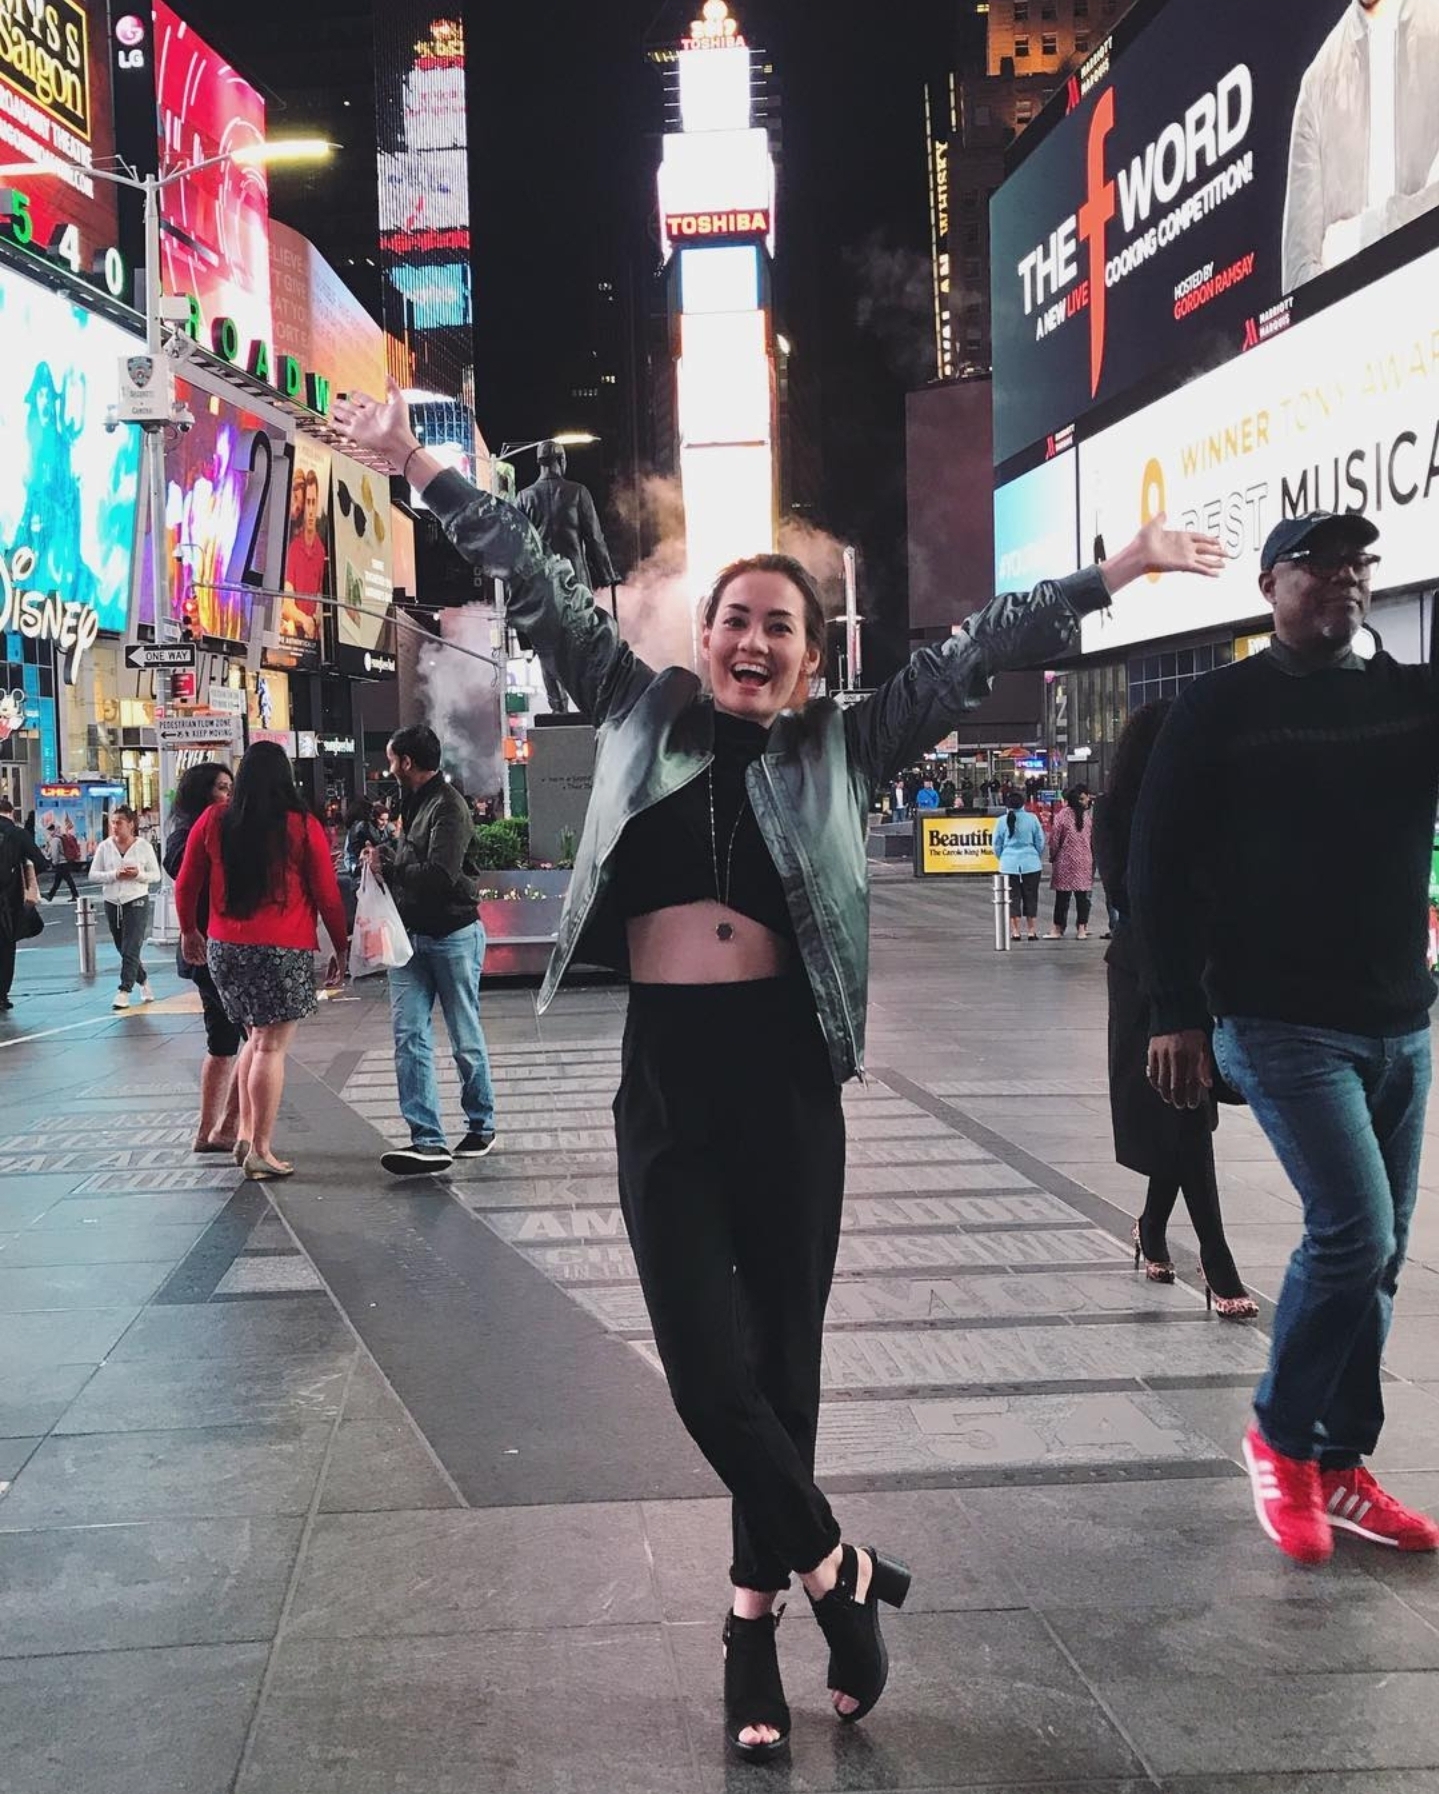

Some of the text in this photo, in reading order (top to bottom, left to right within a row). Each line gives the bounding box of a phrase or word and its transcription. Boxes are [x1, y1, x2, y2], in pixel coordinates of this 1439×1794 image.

[681, 35, 746, 50] TOSHIBA
[118, 49, 144, 69] LG
[1081, 35, 1113, 79] MARRIOTT
[1081, 57, 1110, 96] MARQUIS
[1018, 213, 1077, 315] THE
[1117, 63, 1252, 233] WORD
[667, 212, 767, 235] TOSHIBA
[1035, 317, 1045, 341] A
[1044, 297, 1067, 335] NEW
[1066, 280, 1089, 318] LIVE
[1104, 227, 1157, 288] COOKING
[1174, 261, 1214, 300] HOSTED BY
[1174, 252, 1255, 320] GORDON RAMSAY
[1259, 296, 1294, 325] MARRIOTT
[1259, 312, 1290, 340] MARQUIS
[1181, 410, 1269, 479] WINNER
[145, 651, 188, 661] ONE WAY
[159, 720, 197, 730] PEDESTRIAN
[216, 718, 232, 728] ZONE
[191, 728, 233, 738] KEEP MOVING
[929, 848, 941, 856] The
[942, 848, 962, 856] Carole
[964, 848, 979, 857] King
